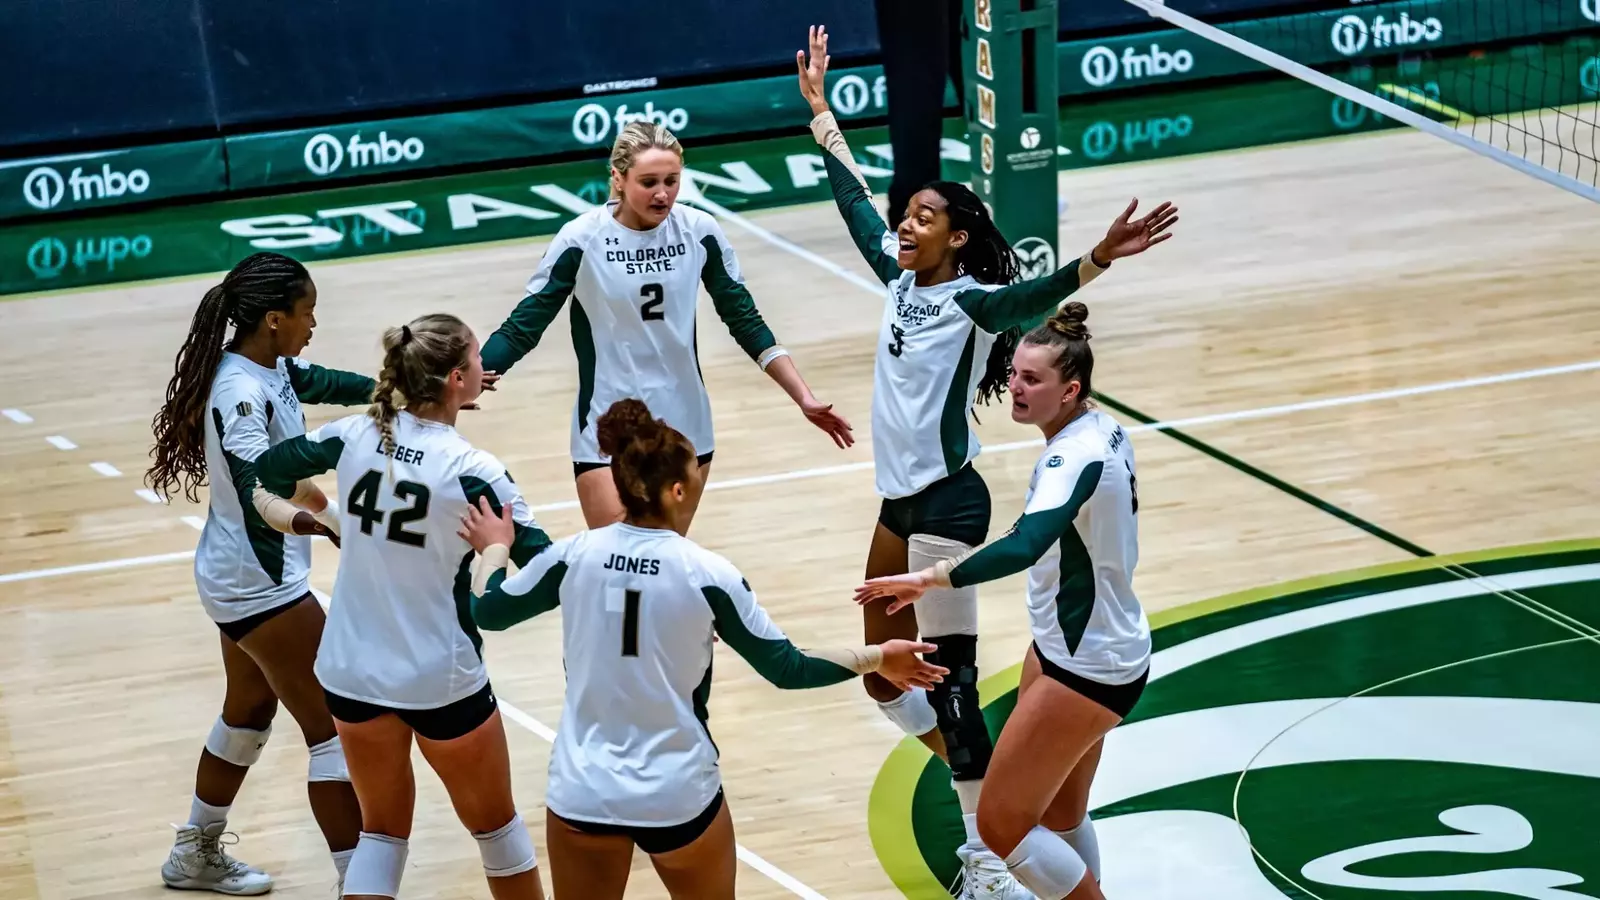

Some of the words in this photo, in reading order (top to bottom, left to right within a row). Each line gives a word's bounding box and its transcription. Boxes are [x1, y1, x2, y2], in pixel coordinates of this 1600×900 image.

[1371, 12, 1442, 47] fnbo
[1121, 43, 1193, 79] fnbo
[347, 131, 424, 168] fnbo
[68, 163, 150, 201] fnbo
[606, 243, 686, 262] COLORADO
[640, 283, 665, 322] 2
[347, 467, 431, 549] 42
[603, 553, 661, 576] JONES
[620, 588, 642, 657] 1
